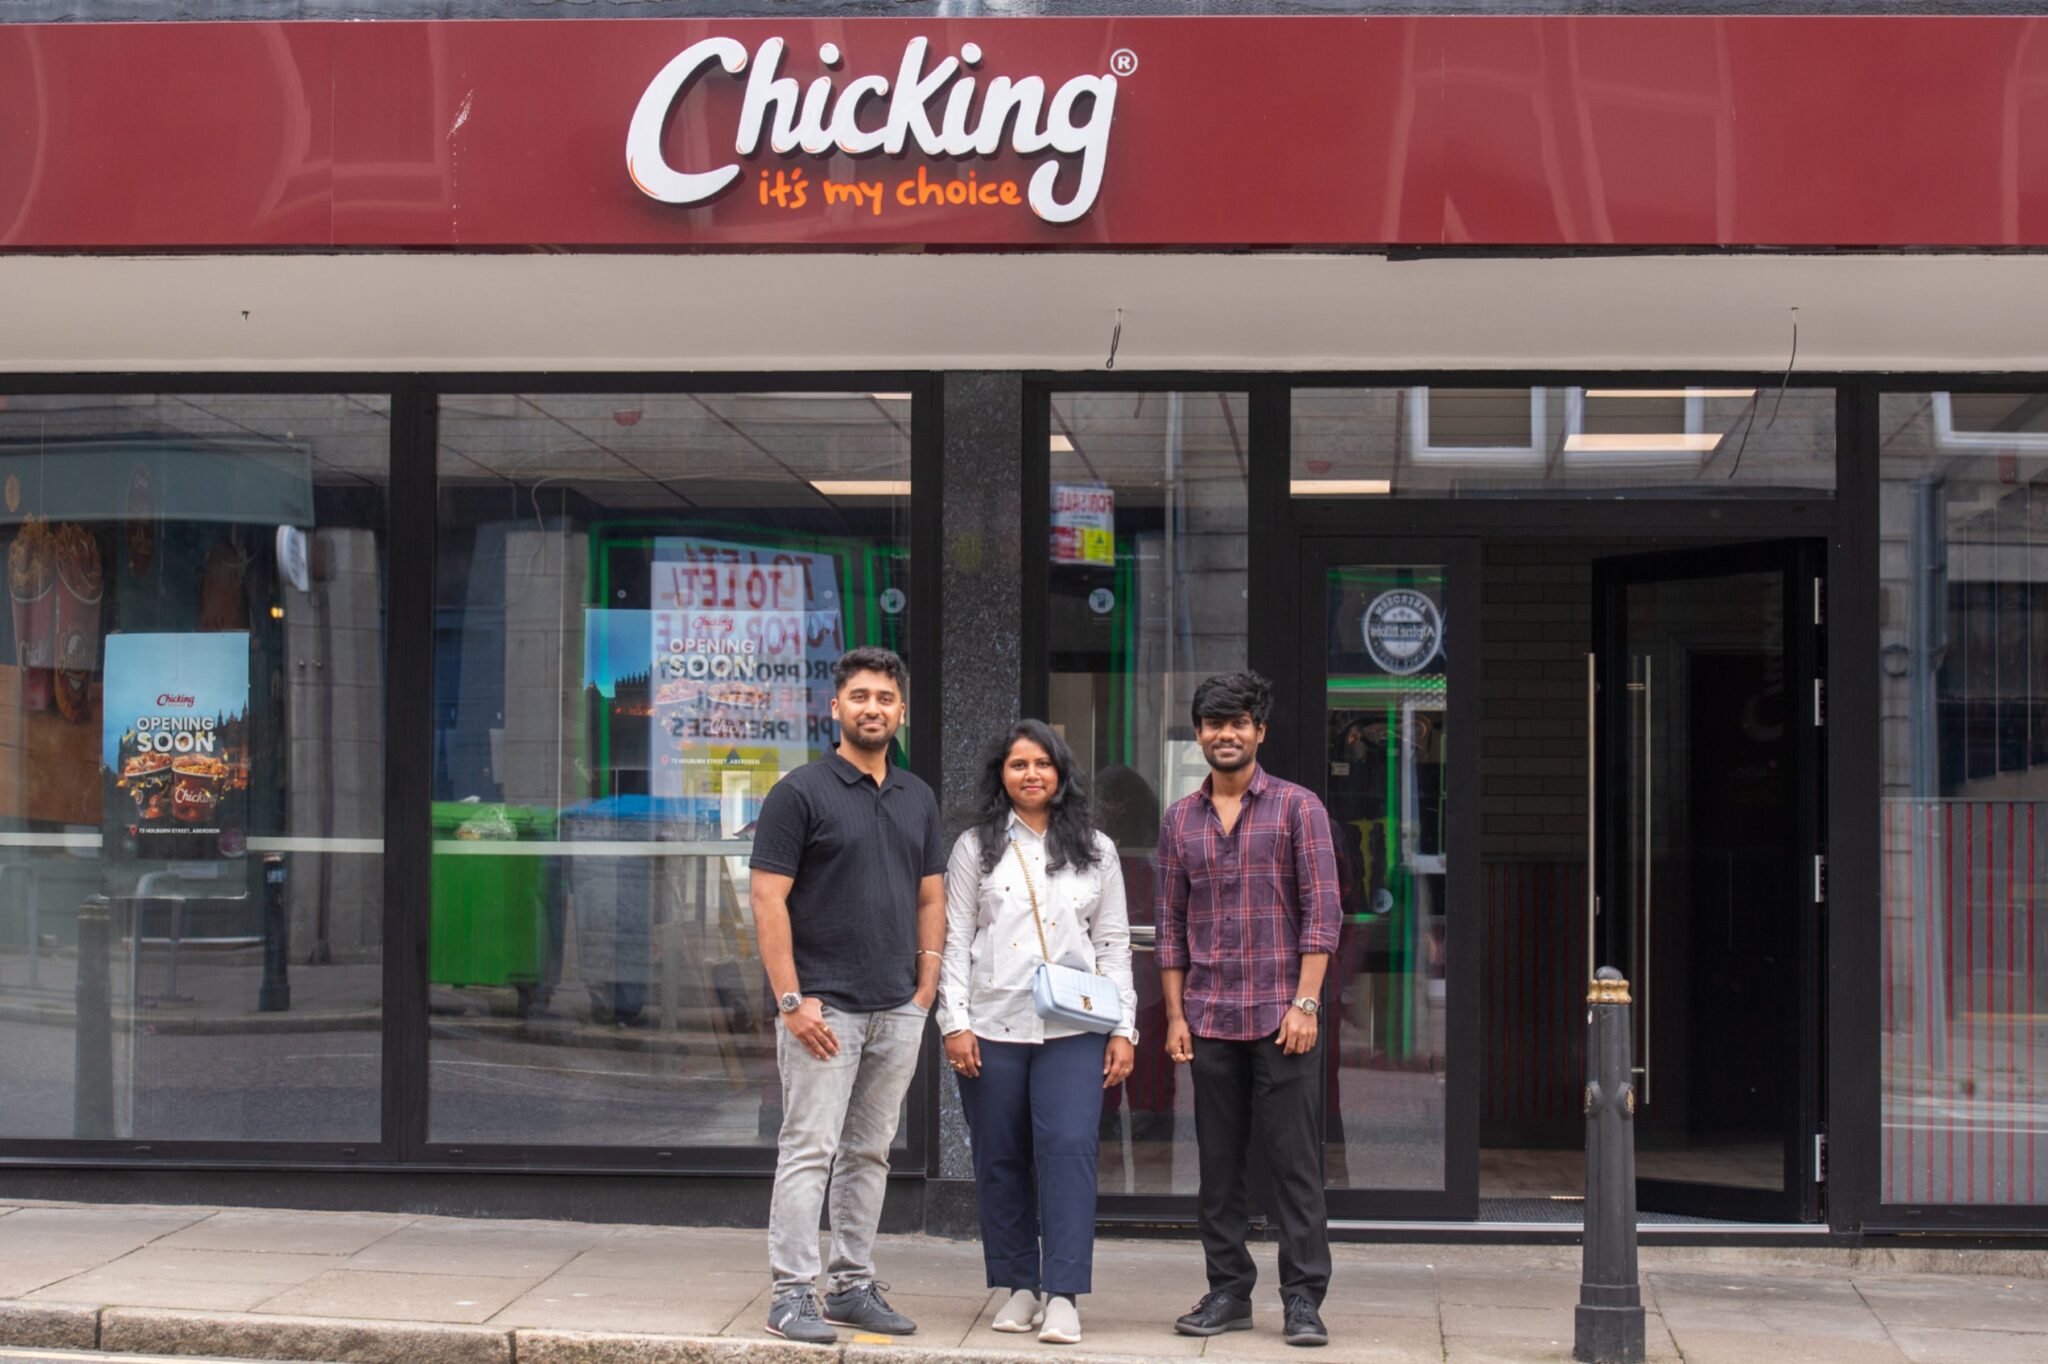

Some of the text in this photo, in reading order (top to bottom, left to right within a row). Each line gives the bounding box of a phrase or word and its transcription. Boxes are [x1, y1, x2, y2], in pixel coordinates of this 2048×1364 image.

[625, 35, 1118, 223] Chicking
[759, 165, 1022, 215] it's my choice
[669, 638, 755, 654] OPENING
[669, 654, 755, 679] SOON
[156, 693, 195, 707] Chicking
[136, 716, 214, 731] OPENING
[136, 731, 215, 752] SOON
